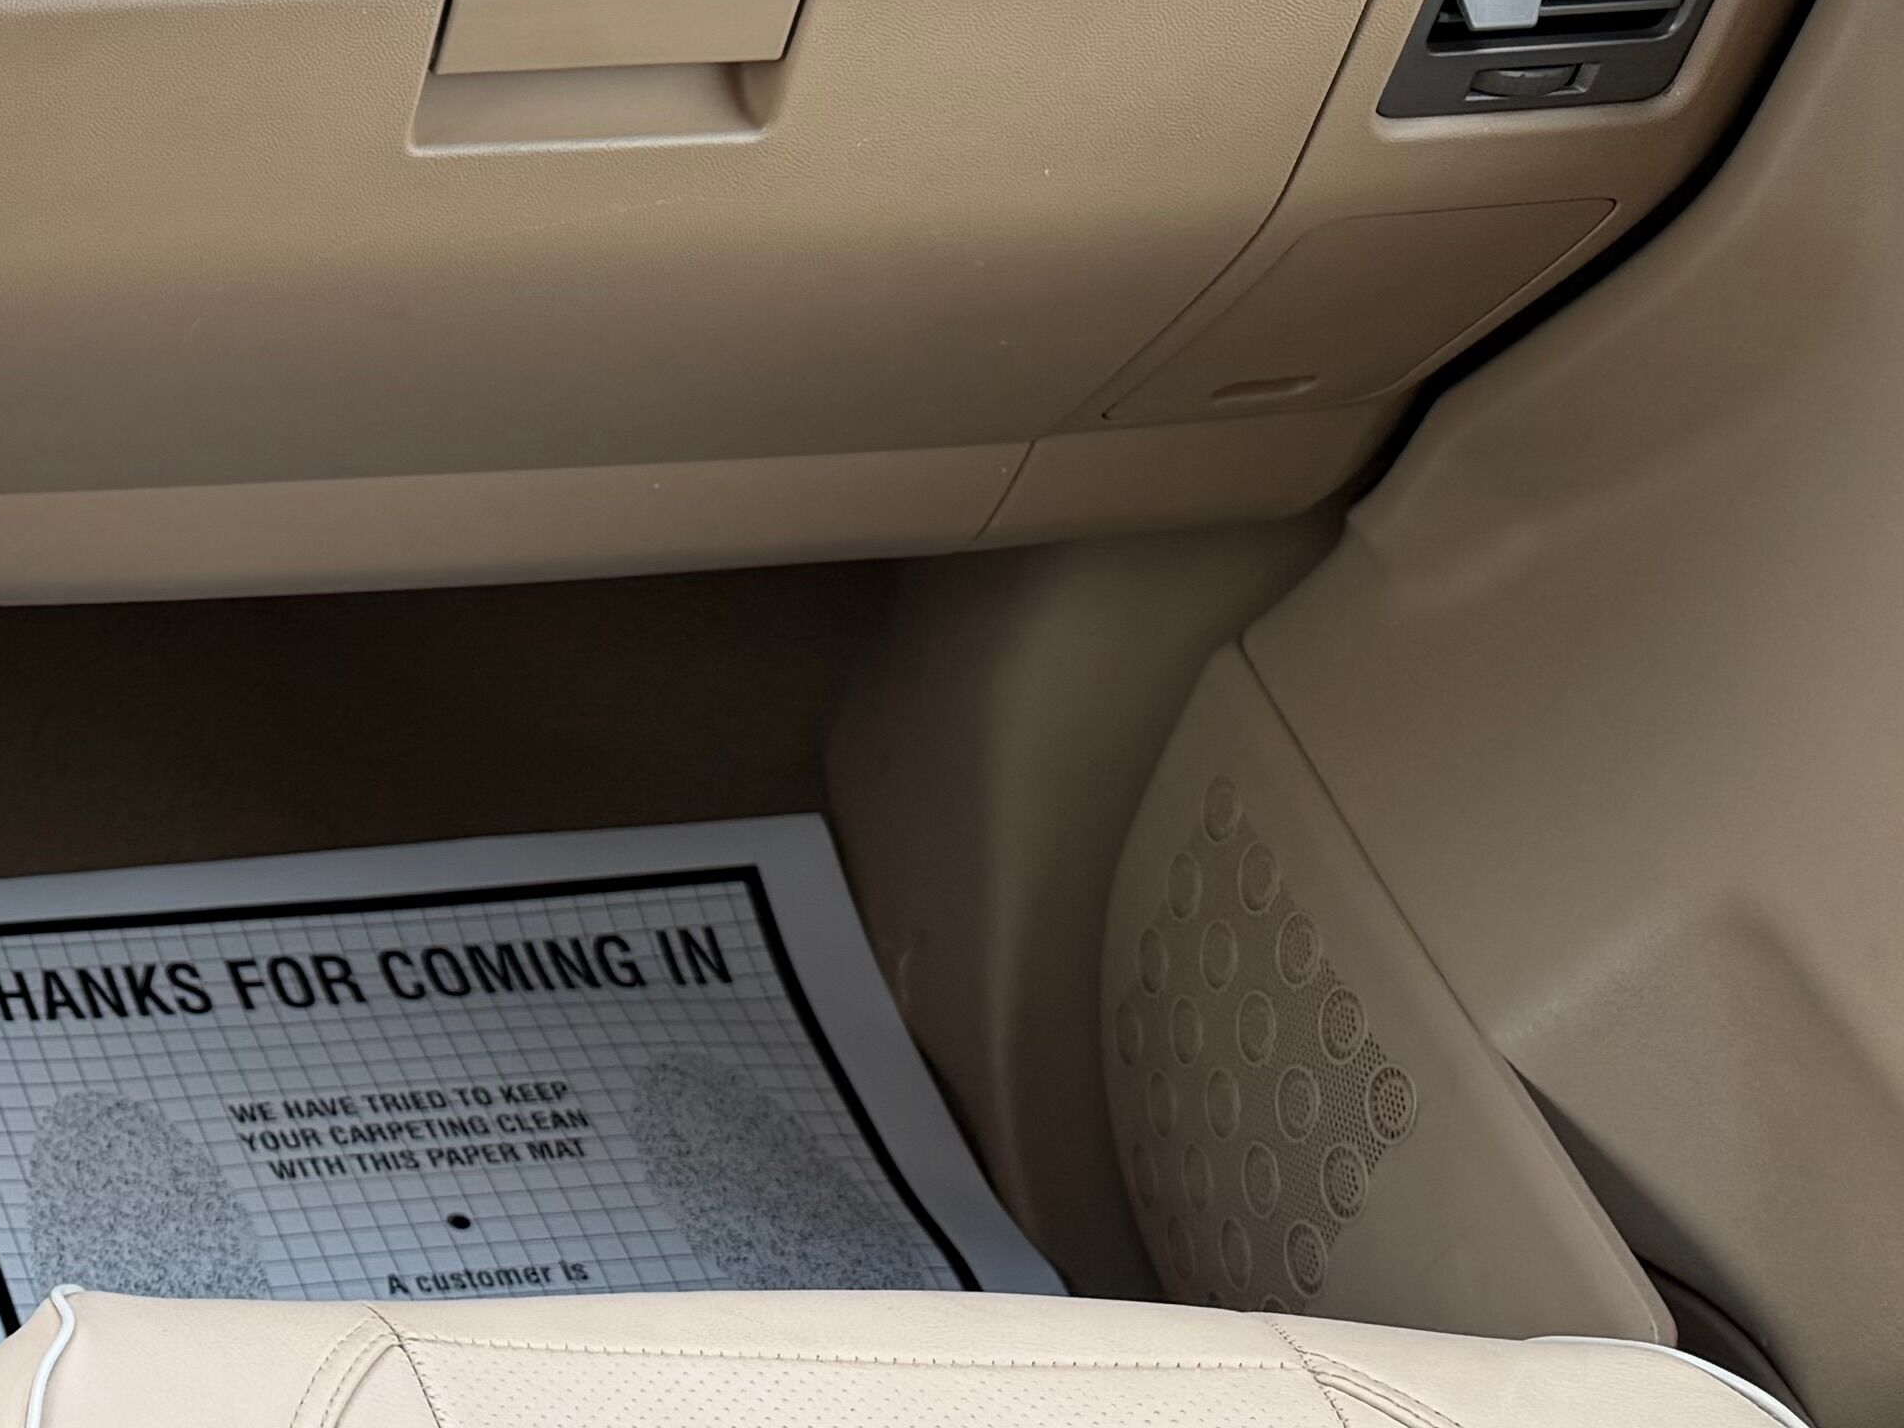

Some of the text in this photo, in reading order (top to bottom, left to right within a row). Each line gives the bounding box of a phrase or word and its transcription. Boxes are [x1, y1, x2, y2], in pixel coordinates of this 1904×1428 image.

[225, 954, 367, 1011] FOR
[376, 933, 647, 1002] COMING
[656, 924, 734, 987] IN
[228, 1081, 569, 1124] WE HAVE TRIED TO KEEP
[241, 1108, 590, 1153] YOUR CARPETING CLEAN
[269, 1138, 588, 1181] WITH THIS PAPER MAT
[387, 1273, 410, 1297] A
[416, 1265, 552, 1295] customer
